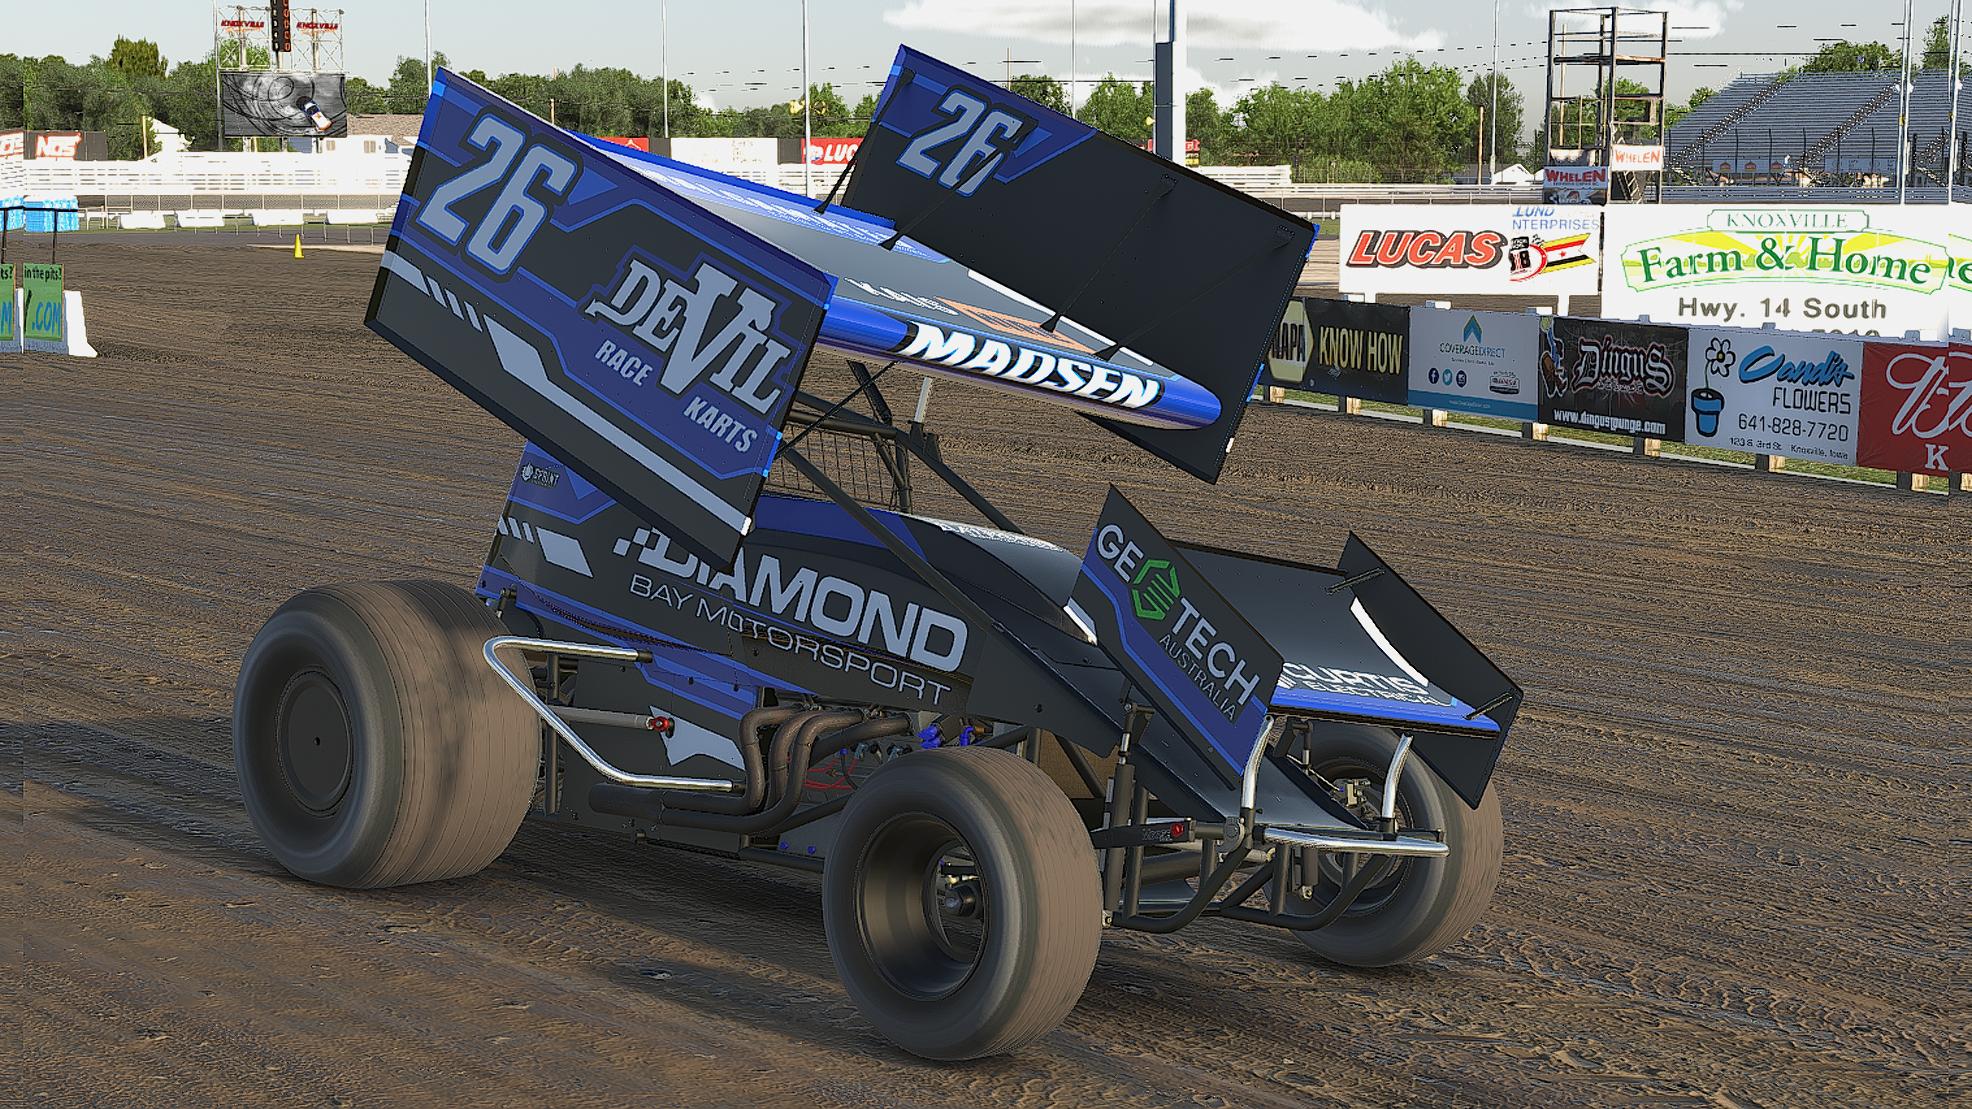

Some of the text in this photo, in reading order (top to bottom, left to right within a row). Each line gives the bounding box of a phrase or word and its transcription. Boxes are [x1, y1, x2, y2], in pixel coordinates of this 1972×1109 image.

[823, 143, 858, 163] LUC
[898, 88, 1024, 197] 26
[1615, 150, 1660, 164] WHELEN
[416, 112, 578, 272] 26
[1545, 168, 1606, 183] WHELEN
[1727, 212, 1848, 229] KNOXVILLE
[1346, 229, 1508, 269] LUCAS
[1638, 246, 1743, 283] Farm
[1807, 236, 1931, 284] Home
[1678, 297, 1887, 322] Hwy. 14 South
[595, 339, 653, 386] RACE
[900, 321, 1161, 409] MADSEN
[1320, 326, 1403, 375] KNOW HOW
[683, 396, 757, 452] KARTS
[1772, 387, 1851, 415] FLOWERS
[1738, 413, 1849, 442] 641-828-7720
[630, 573, 951, 706] BAY MOTORSPORT
[1159, 634, 1237, 721] AUSTRALIA
